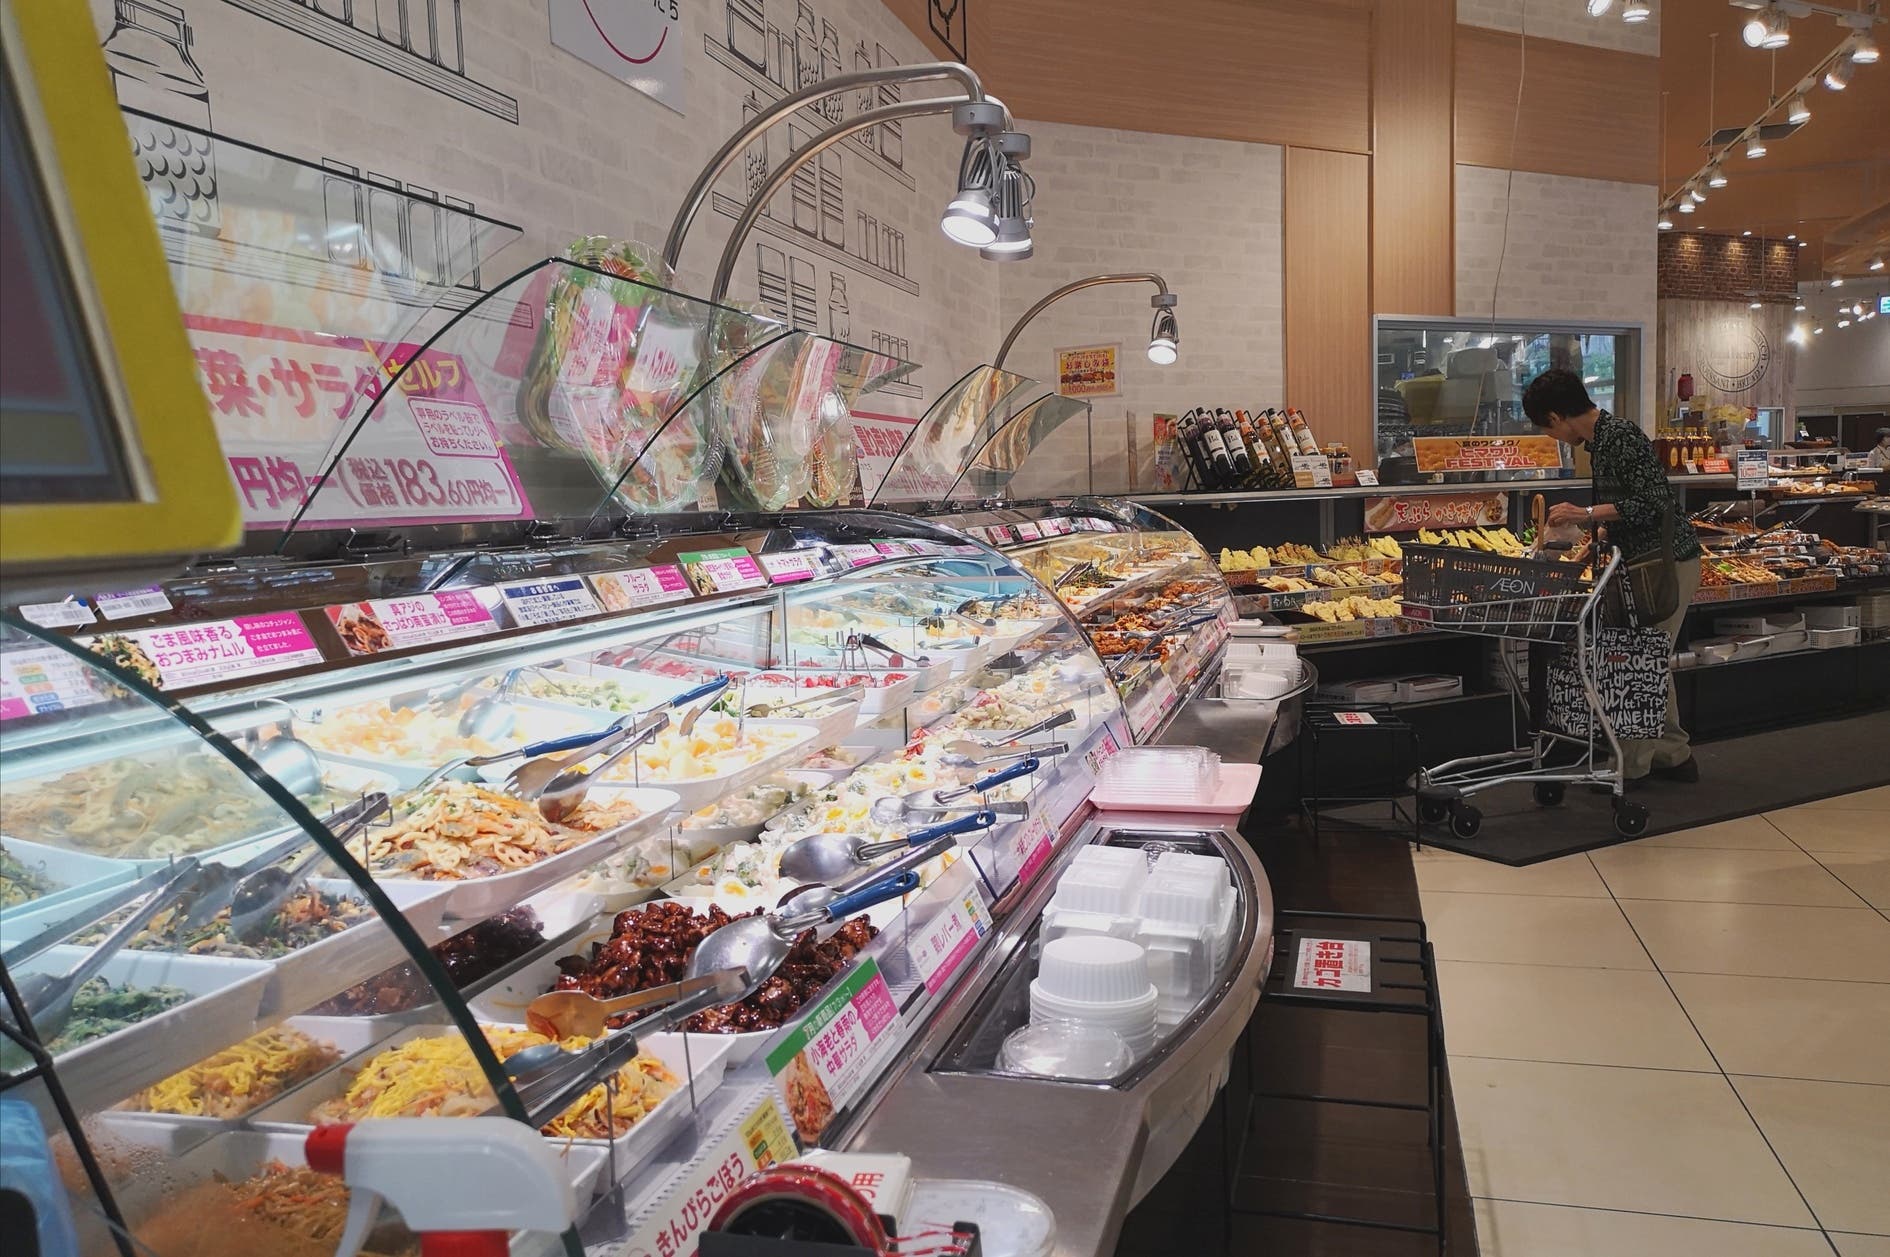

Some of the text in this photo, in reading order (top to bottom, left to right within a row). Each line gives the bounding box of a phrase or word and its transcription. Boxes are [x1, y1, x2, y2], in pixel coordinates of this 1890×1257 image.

[430, 436, 493, 451] お持ちください。
[1460, 447, 1518, 458] ヒマワリ
[1394, 501, 1483, 524] 天ぷら かき揚げ
[389, 600, 425, 616] 真アジの
[382, 612, 447, 632] さっぱり南蛮漬け
[150, 625, 234, 650] ごま風味香る
[155, 641, 245, 668] おつまみナムル
[1312, 941, 1345, 988] カゴ置き台
[810, 1009, 857, 1066] 小海老と春雨の
[825, 1036, 860, 1075] 中華サラダ
[655, 1152, 745, 1257] きんぴらごぼう
